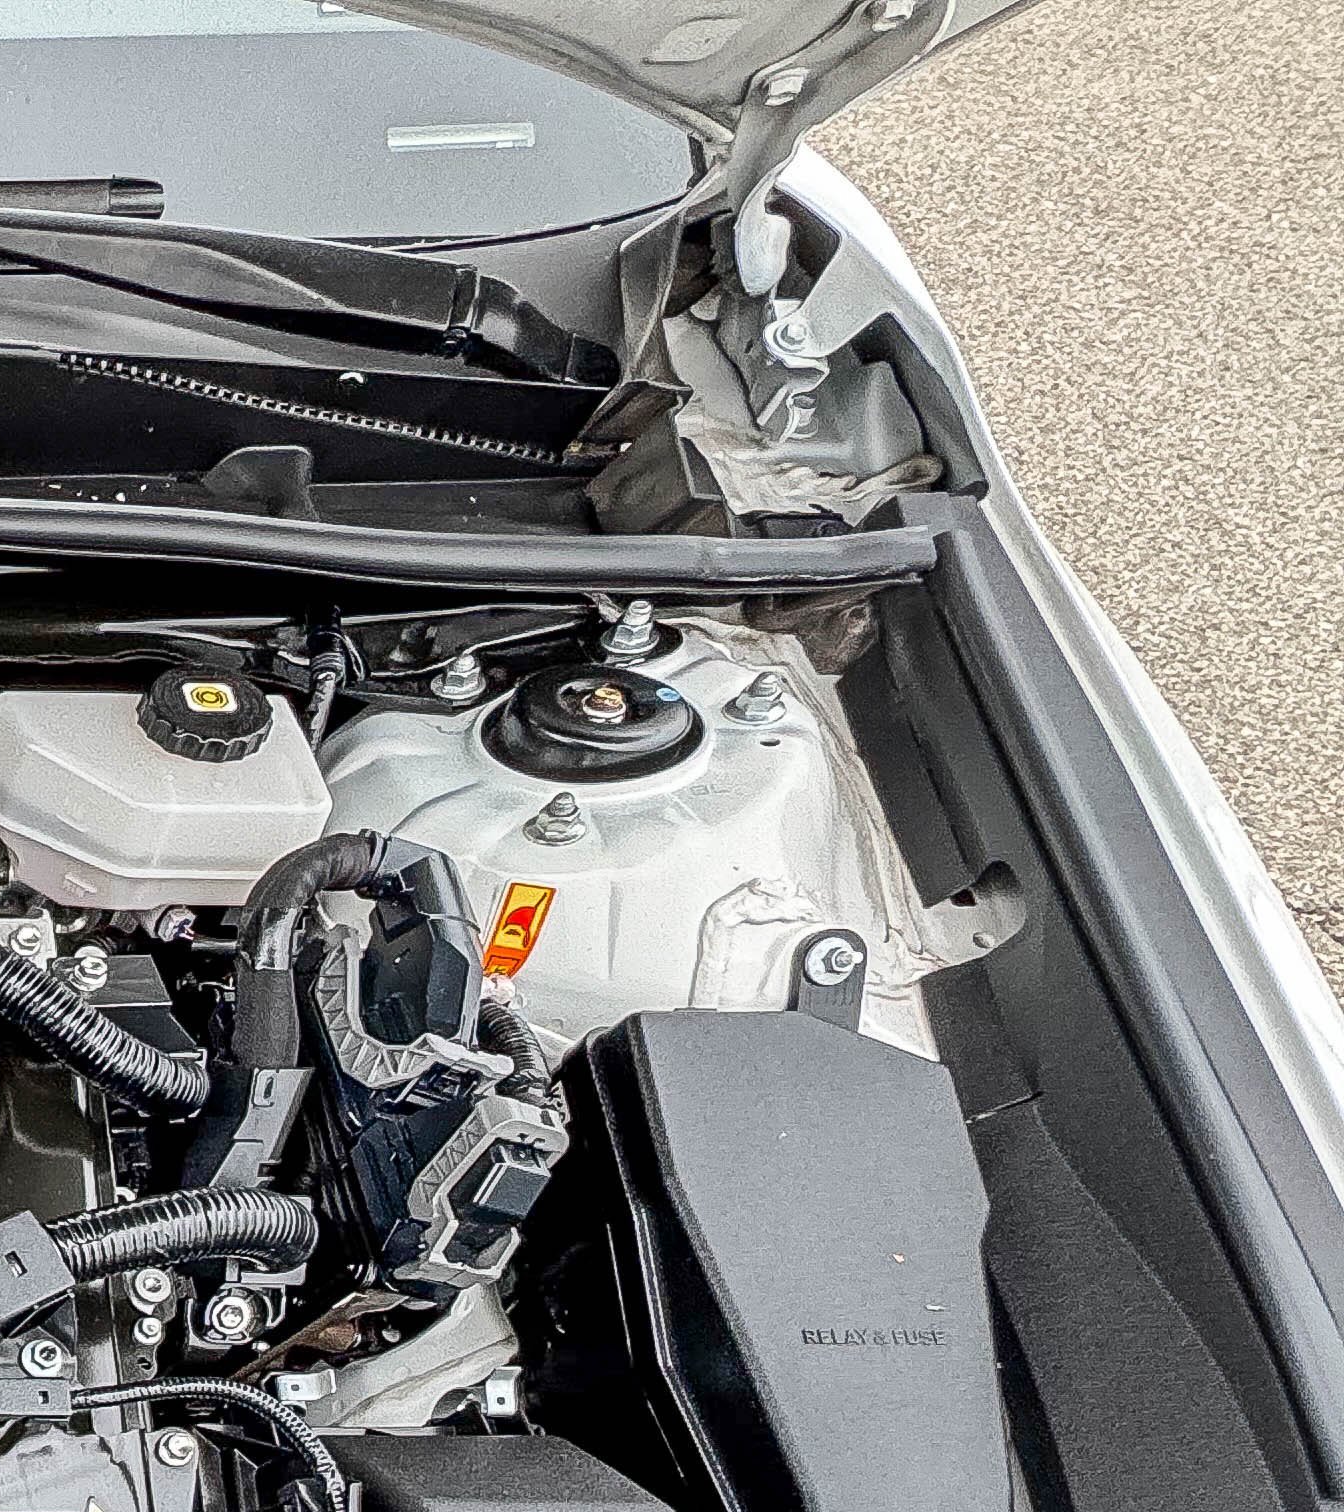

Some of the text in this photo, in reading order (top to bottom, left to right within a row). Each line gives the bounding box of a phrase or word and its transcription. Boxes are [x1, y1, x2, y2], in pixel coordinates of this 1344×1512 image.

[801, 1328, 948, 1346] RELAY & FUSE
